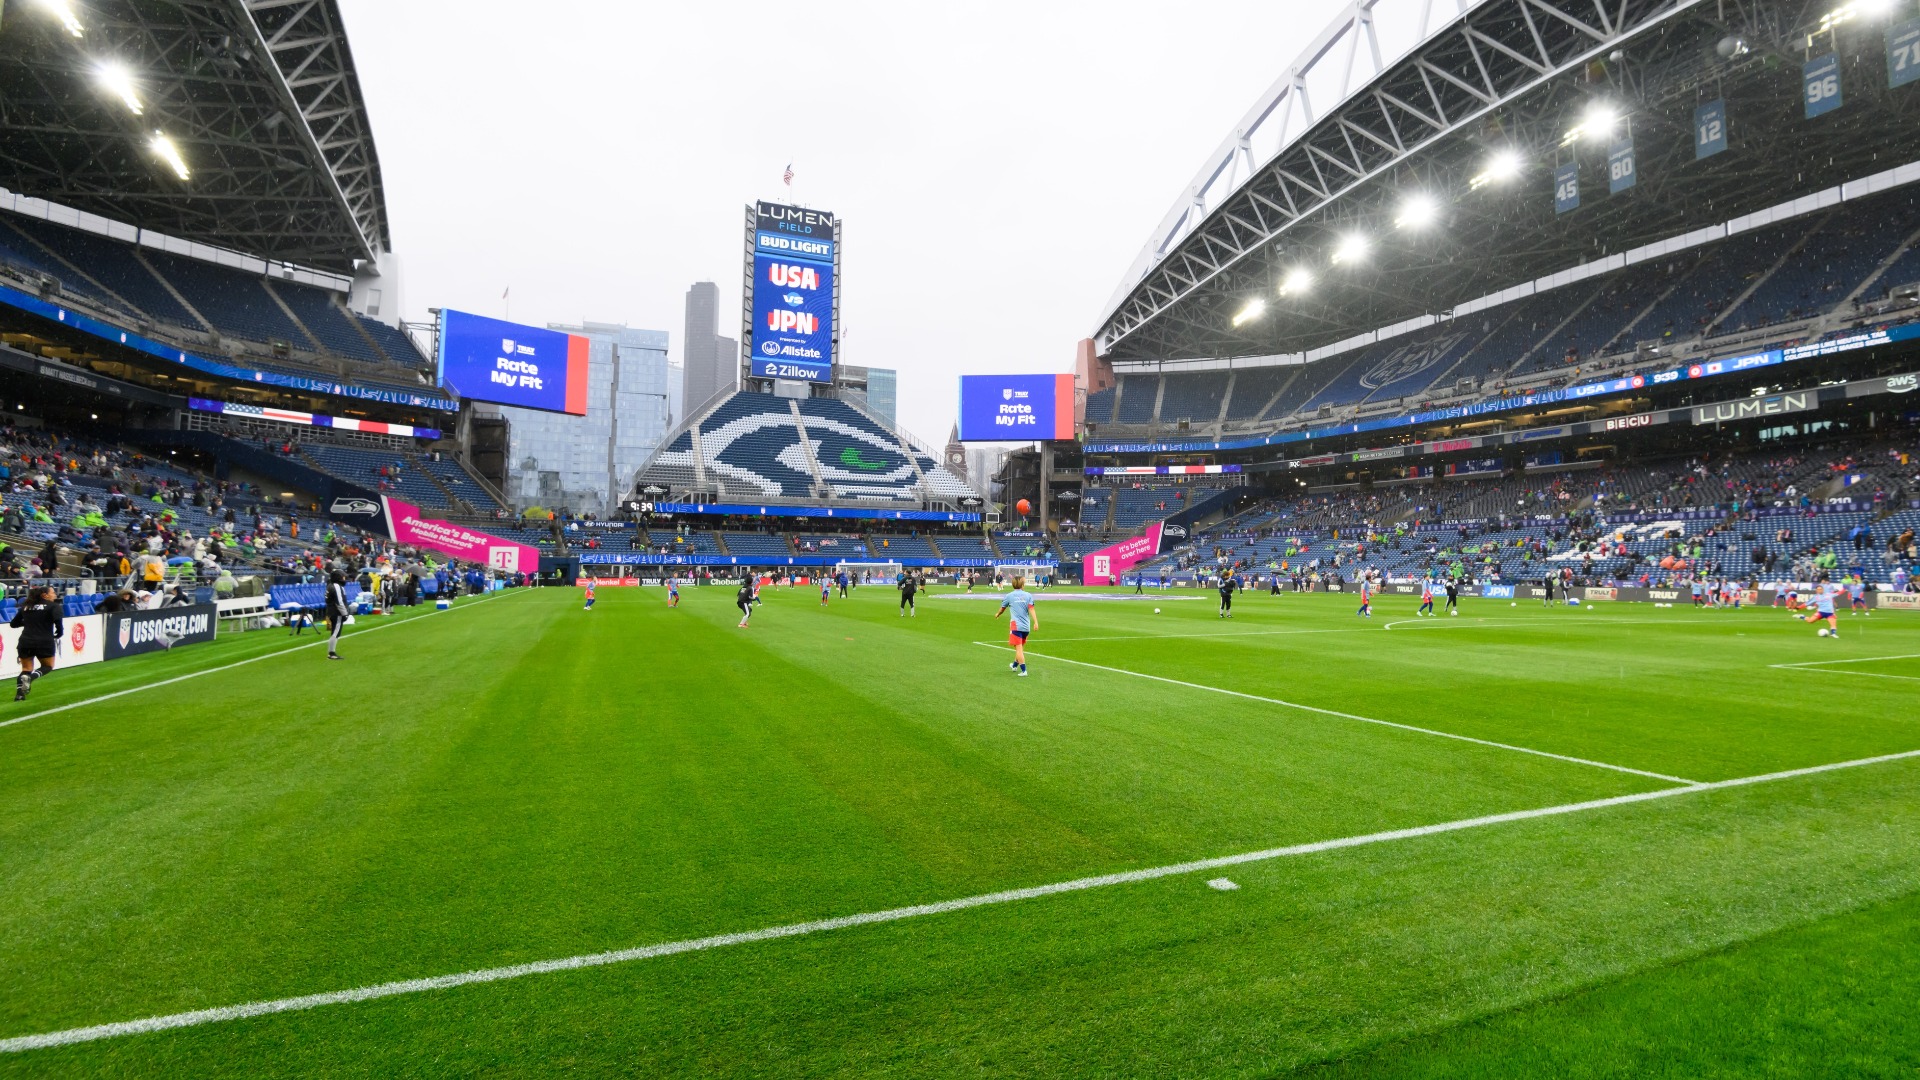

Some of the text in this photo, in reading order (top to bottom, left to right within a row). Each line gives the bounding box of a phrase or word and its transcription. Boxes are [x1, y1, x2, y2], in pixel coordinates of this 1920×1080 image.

[1893, 40, 1920, 71] 71
[1807, 75, 1837, 103] 96
[1700, 120, 1721, 145] 12
[1611, 157, 1632, 180] 80
[1556, 180, 1577, 200] 45
[758, 205, 833, 227] LUMEN
[779, 222, 812, 234] FIELD
[761, 236, 829, 255] BUD LIGHT
[771, 263, 817, 290] USA
[769, 309, 813, 335] JPN
[781, 345, 820, 358] Allstate
[1820, 346, 1838, 355] THAT
[497, 357, 538, 375] Rate
[779, 364, 818, 378] Zillow
[1577, 355, 1769, 395] USA 9:39 JPN
[491, 370, 543, 390] My Fit
[1887, 375, 1917, 387] aws
[1000, 404, 1031, 413] Rate
[1699, 393, 1806, 422] LUMEN
[996, 415, 1035, 426] My Fit
[630, 502, 653, 512] 9:39
[402, 516, 460, 539] America's
[461, 532, 487, 545] Best
[410, 527, 439, 540] Mobile
[439, 535, 473, 549] Network
[1119, 537, 1150, 553] It's better
[1121, 545, 1151, 559] over here
[1487, 587, 1509, 596] JPN
[1649, 591, 1678, 599] TRULY
[133, 614, 208, 643] USSOCCER.COM
